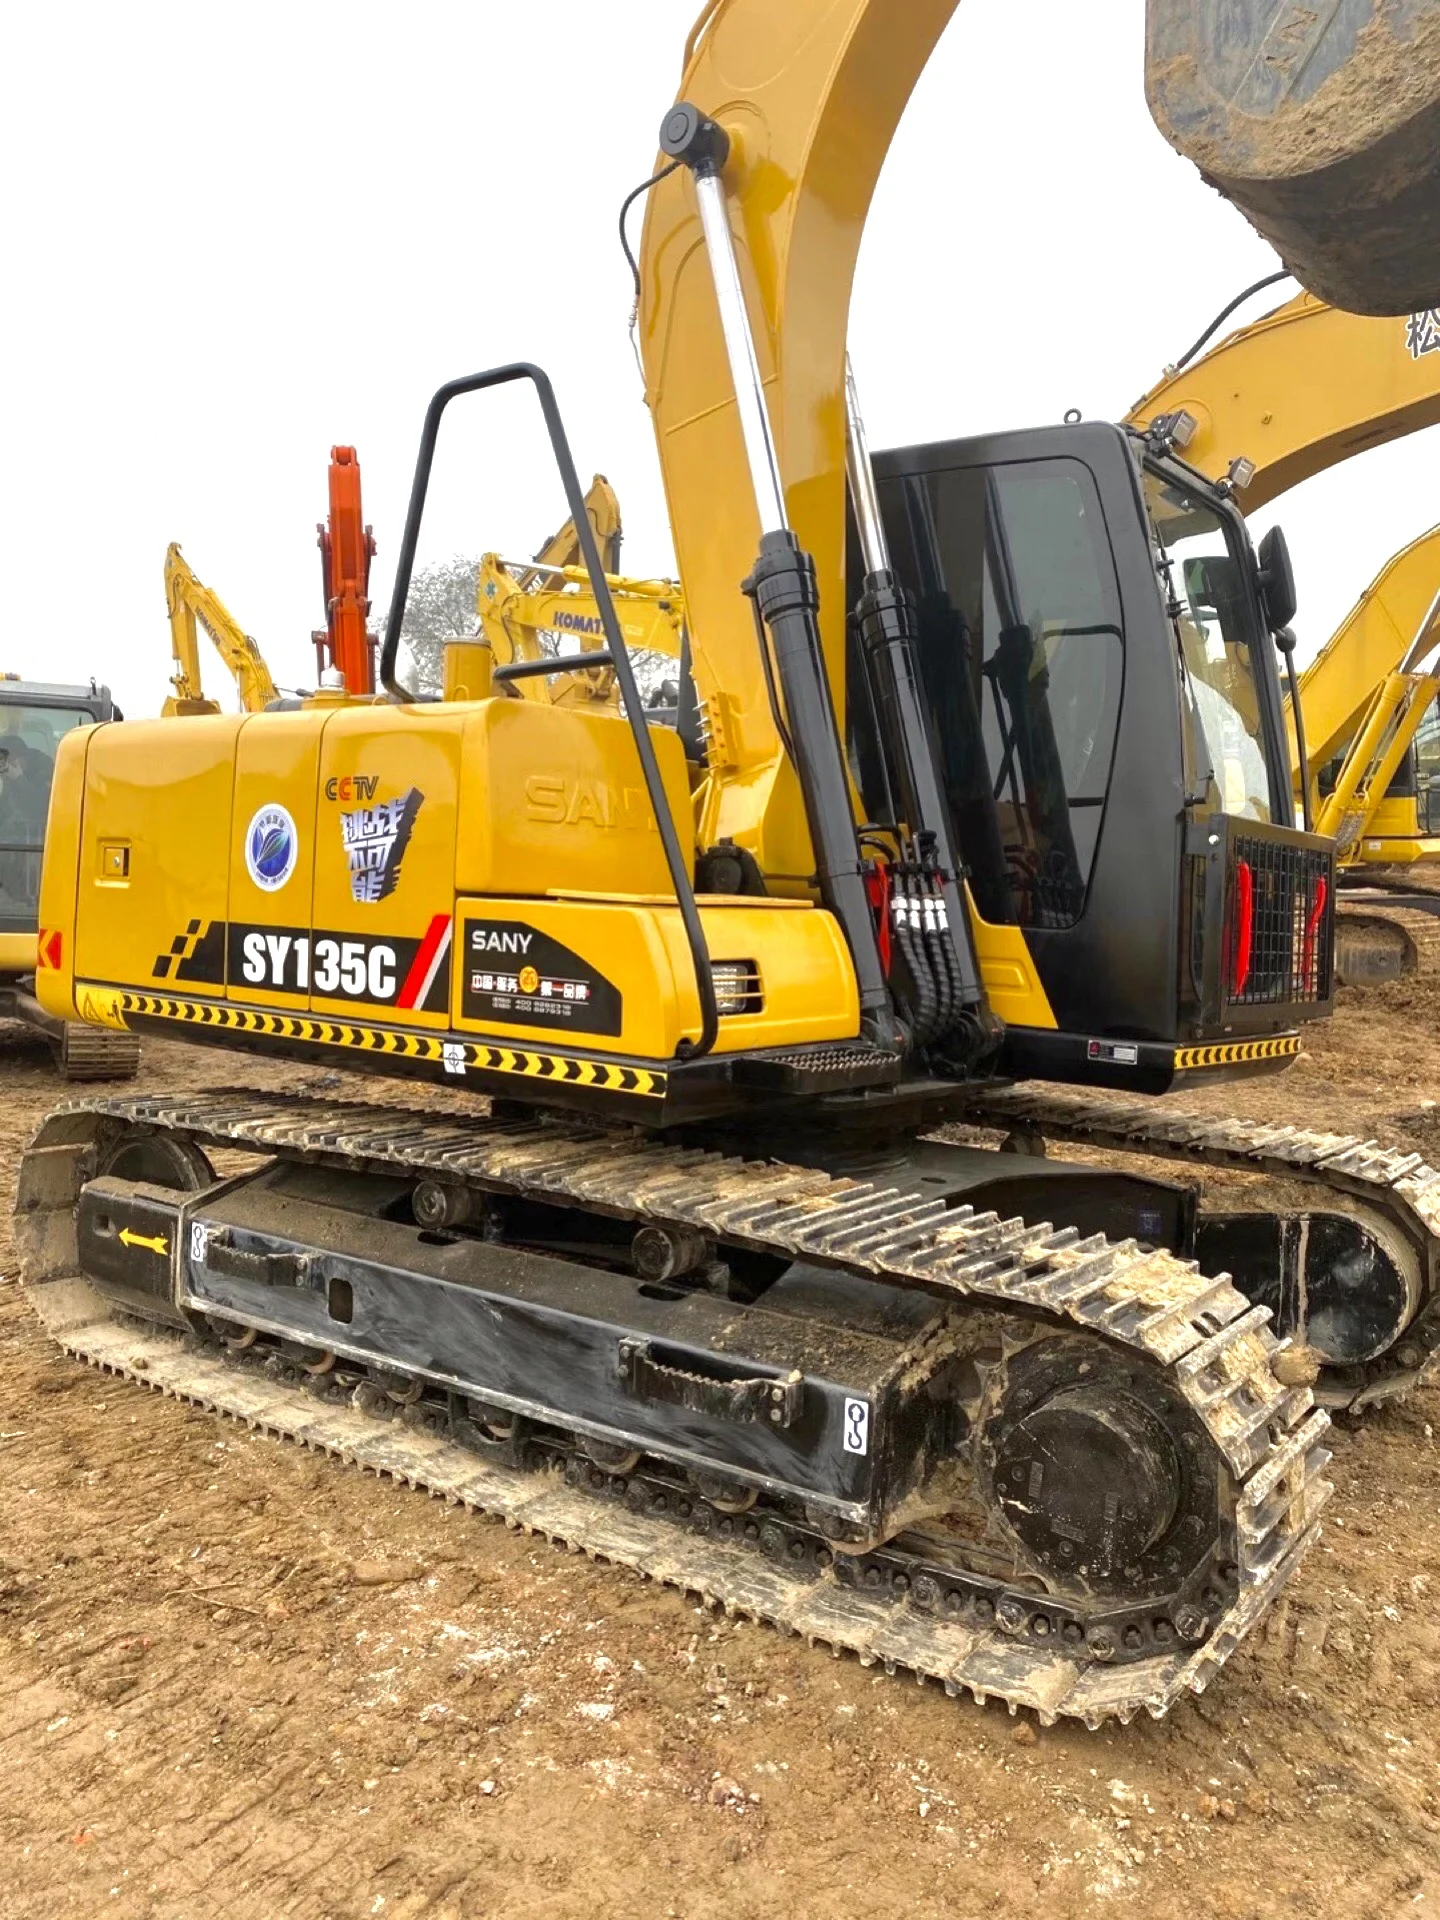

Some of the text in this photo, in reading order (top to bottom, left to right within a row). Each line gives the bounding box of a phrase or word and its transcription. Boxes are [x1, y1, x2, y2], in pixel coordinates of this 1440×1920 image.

[553, 611, 606, 635] KOMAT
[325, 776, 379, 801] CCTV
[340, 789, 412, 844] 挑战
[342, 834, 398, 873] 不可
[350, 868, 387, 904] 能
[472, 930, 533, 954] SANY
[242, 932, 397, 998] SY135C
